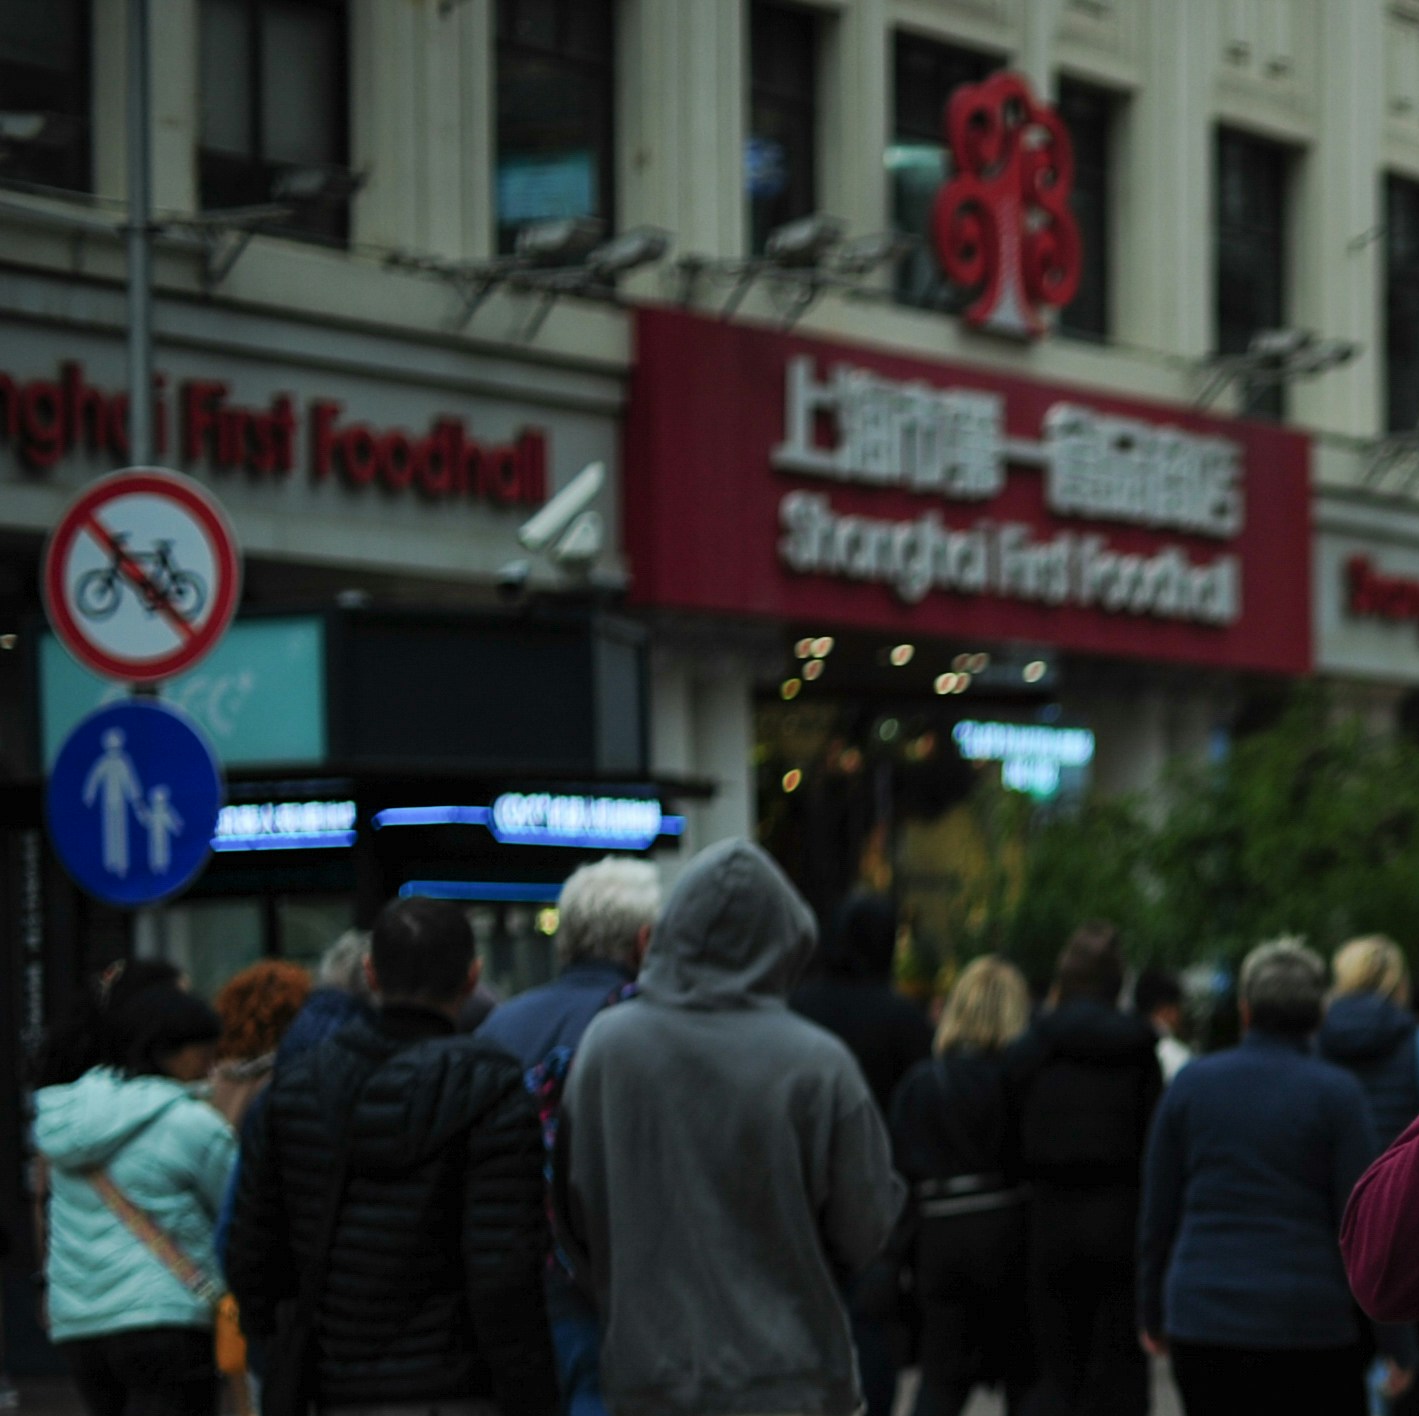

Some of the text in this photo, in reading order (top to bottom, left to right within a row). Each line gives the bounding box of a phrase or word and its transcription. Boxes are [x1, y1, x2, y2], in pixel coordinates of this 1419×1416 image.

[181, 379, 295, 475] First
[310, 400, 550, 505] Foodhall
[779, 490, 998, 606] Shanghai
